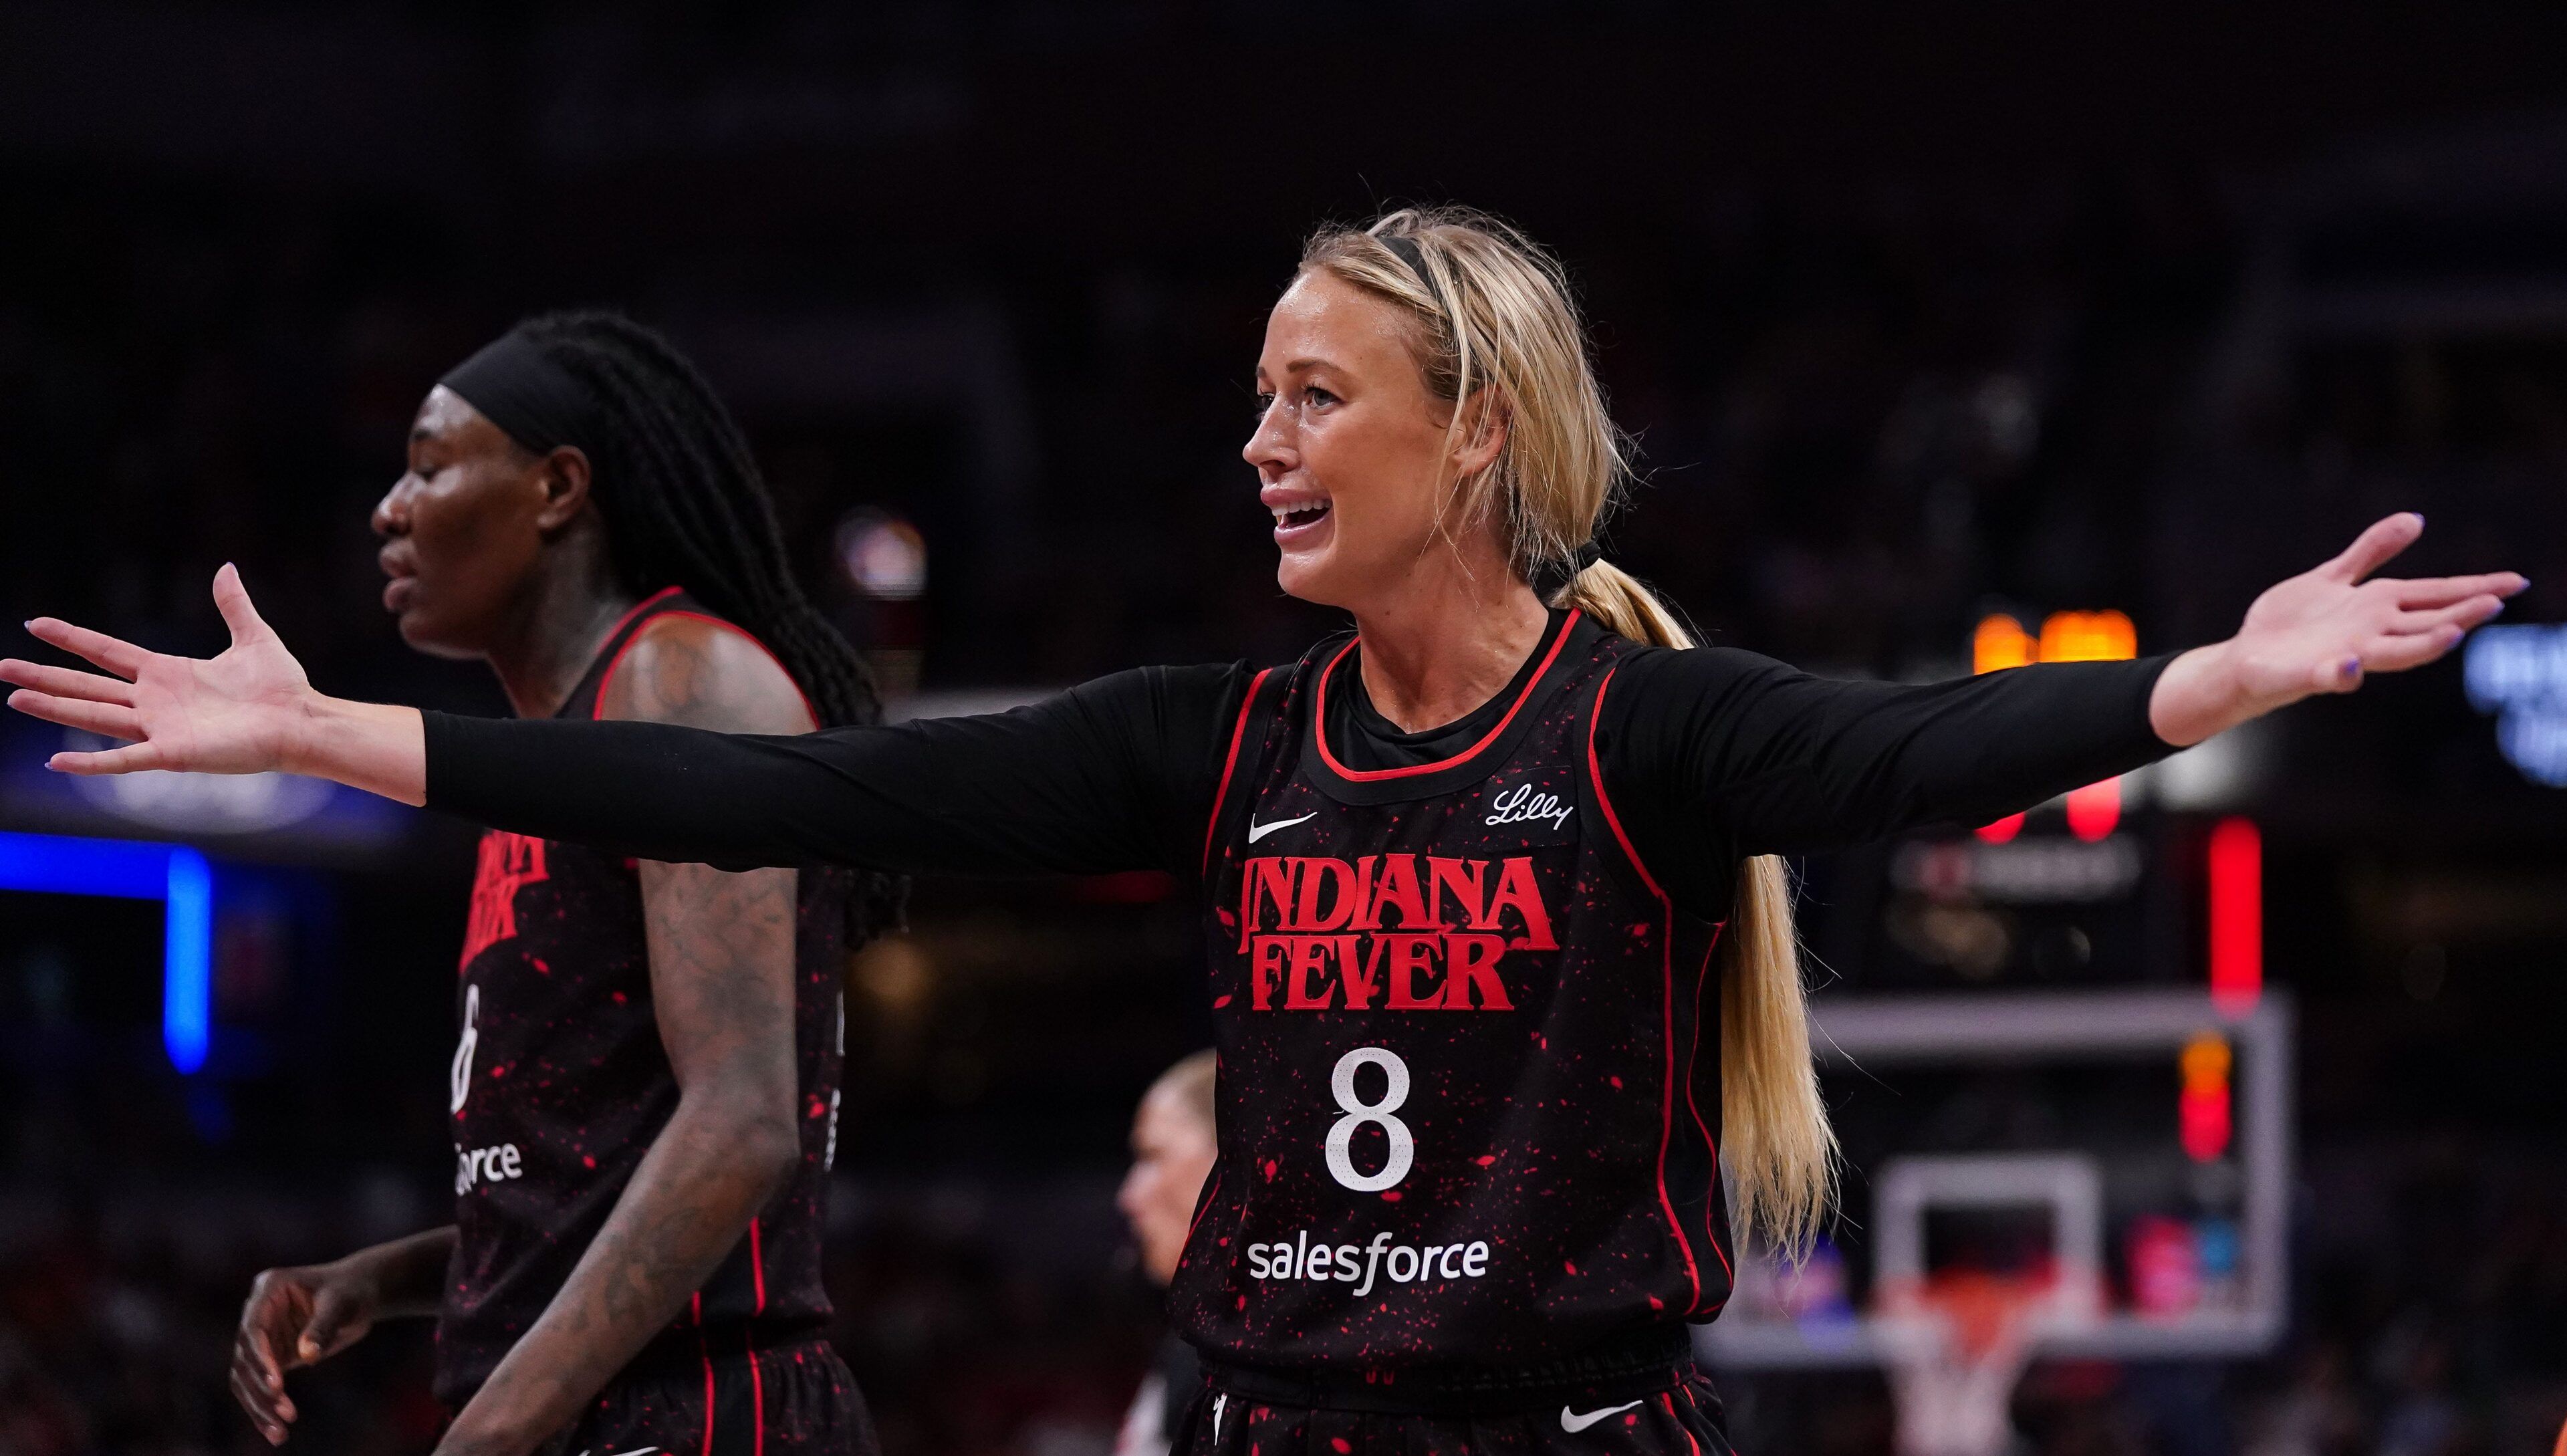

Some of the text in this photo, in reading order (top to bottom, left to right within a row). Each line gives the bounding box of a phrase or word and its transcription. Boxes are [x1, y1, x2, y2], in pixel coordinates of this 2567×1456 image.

[1485, 783, 1574, 830] Lilly
[1237, 853, 1560, 955] INDIANA
[1252, 933, 1515, 1011] FEVER
[1325, 1047, 1414, 1192] 8
[1247, 1229, 1489, 1297] salesforce
